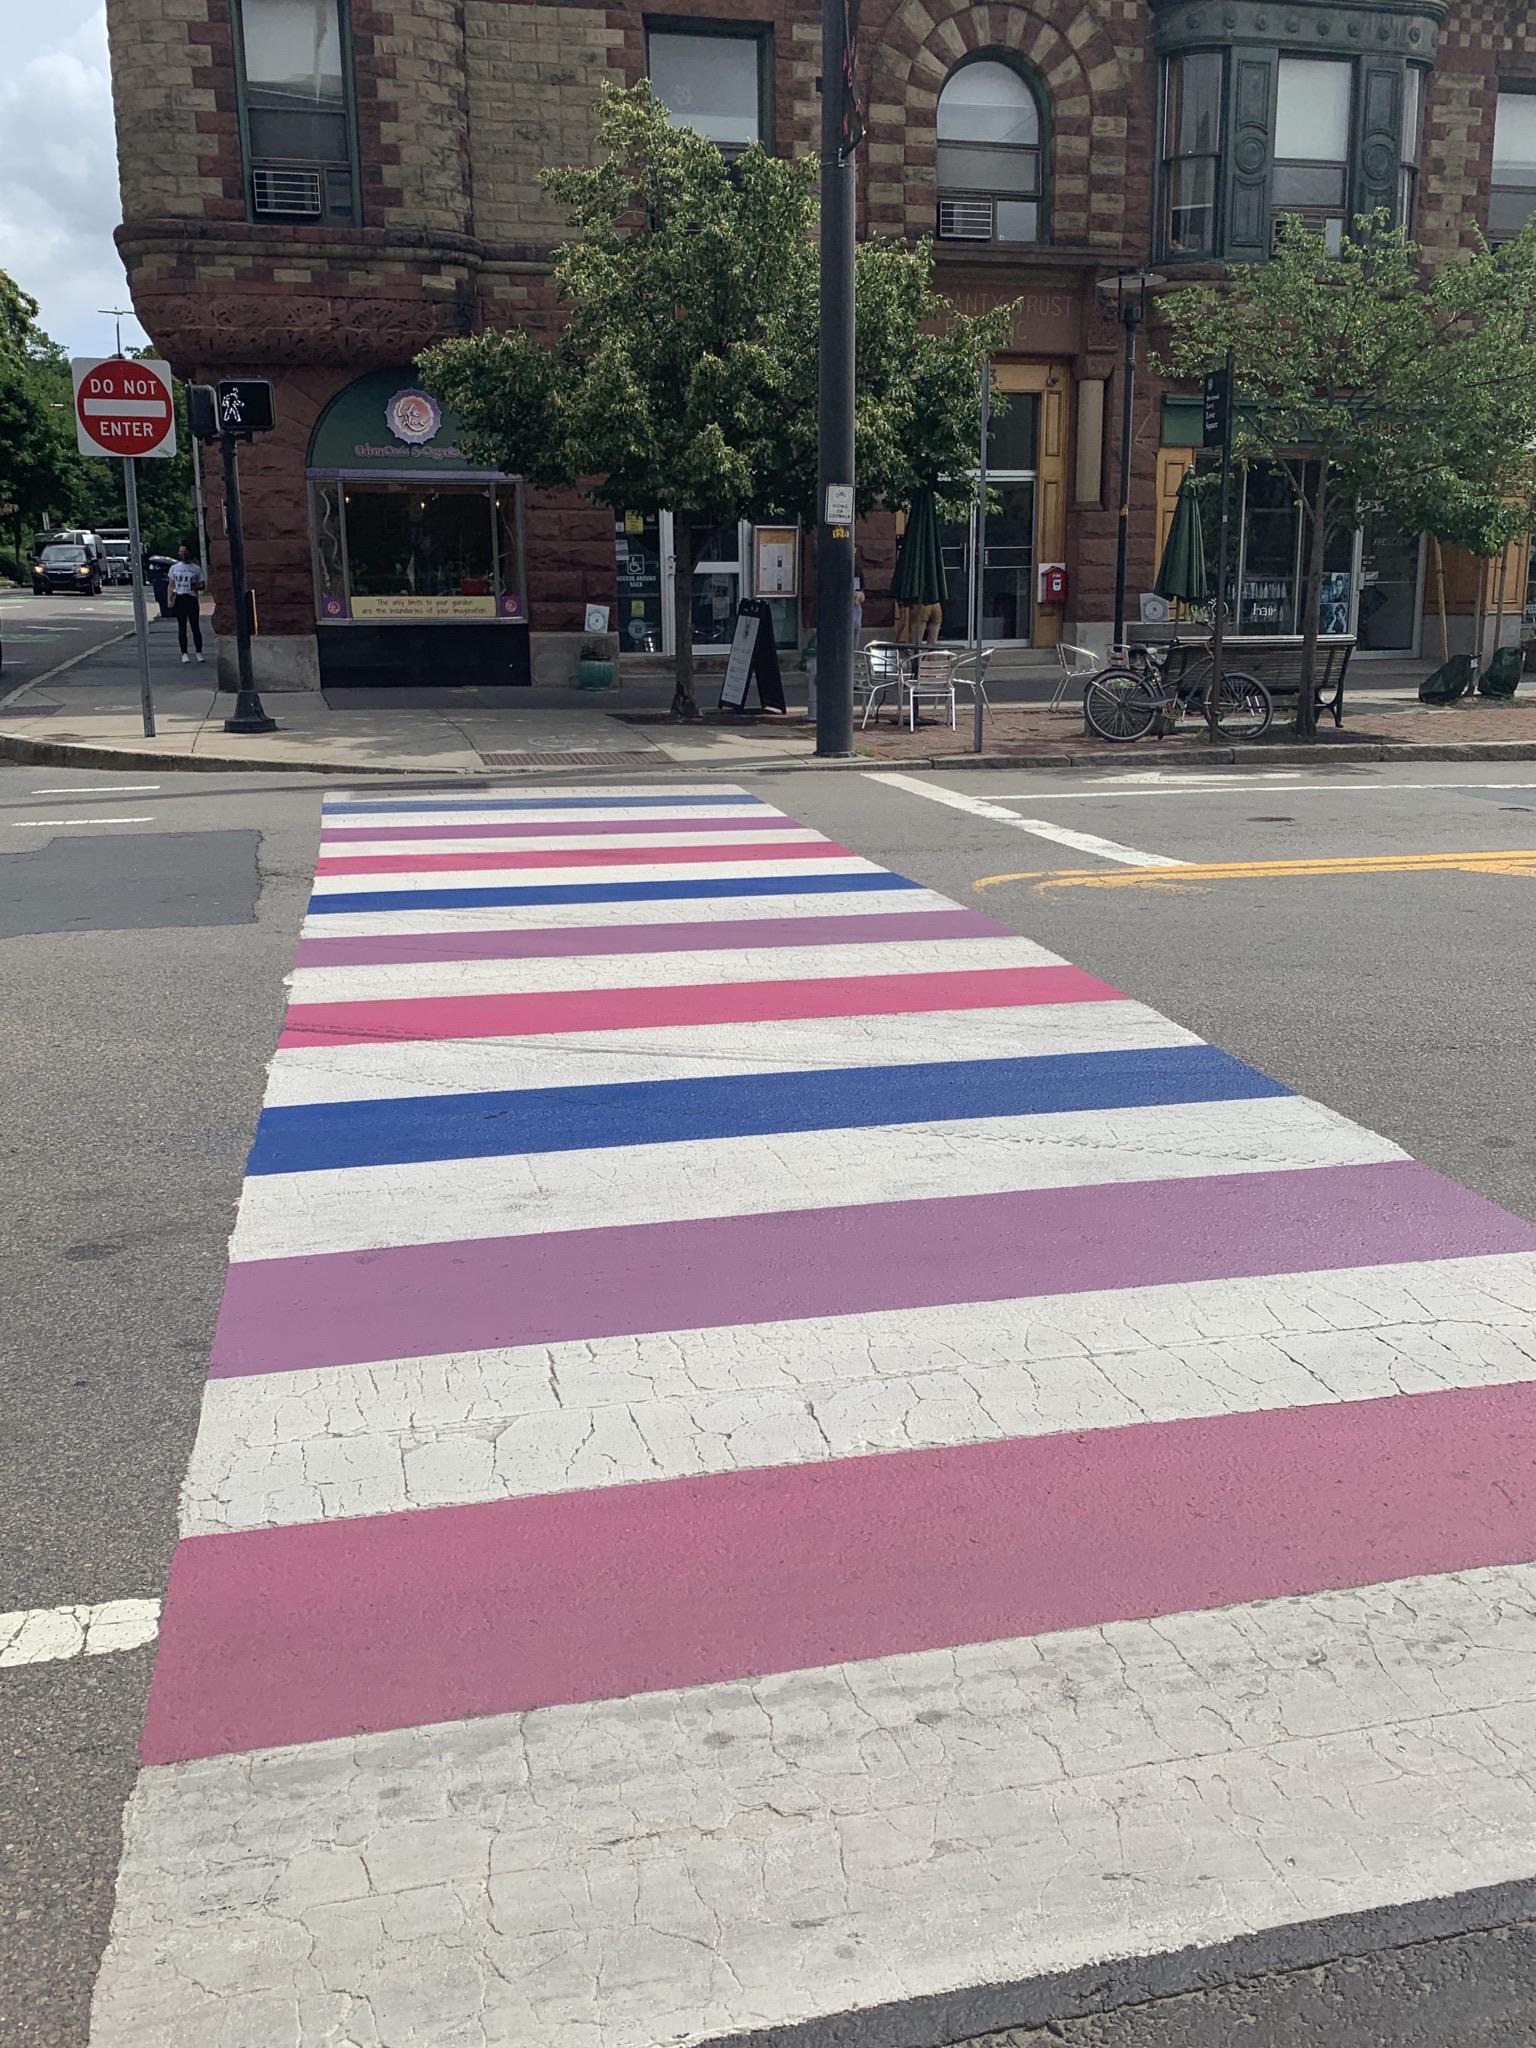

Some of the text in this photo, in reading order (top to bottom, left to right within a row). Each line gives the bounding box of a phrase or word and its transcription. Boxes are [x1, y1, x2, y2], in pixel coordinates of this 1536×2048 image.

[1013, 295, 1073, 317] RUST
[90, 379, 157, 396] DO NOT
[100, 421, 154, 437] ENTER
[1253, 603, 1277, 617] hair
